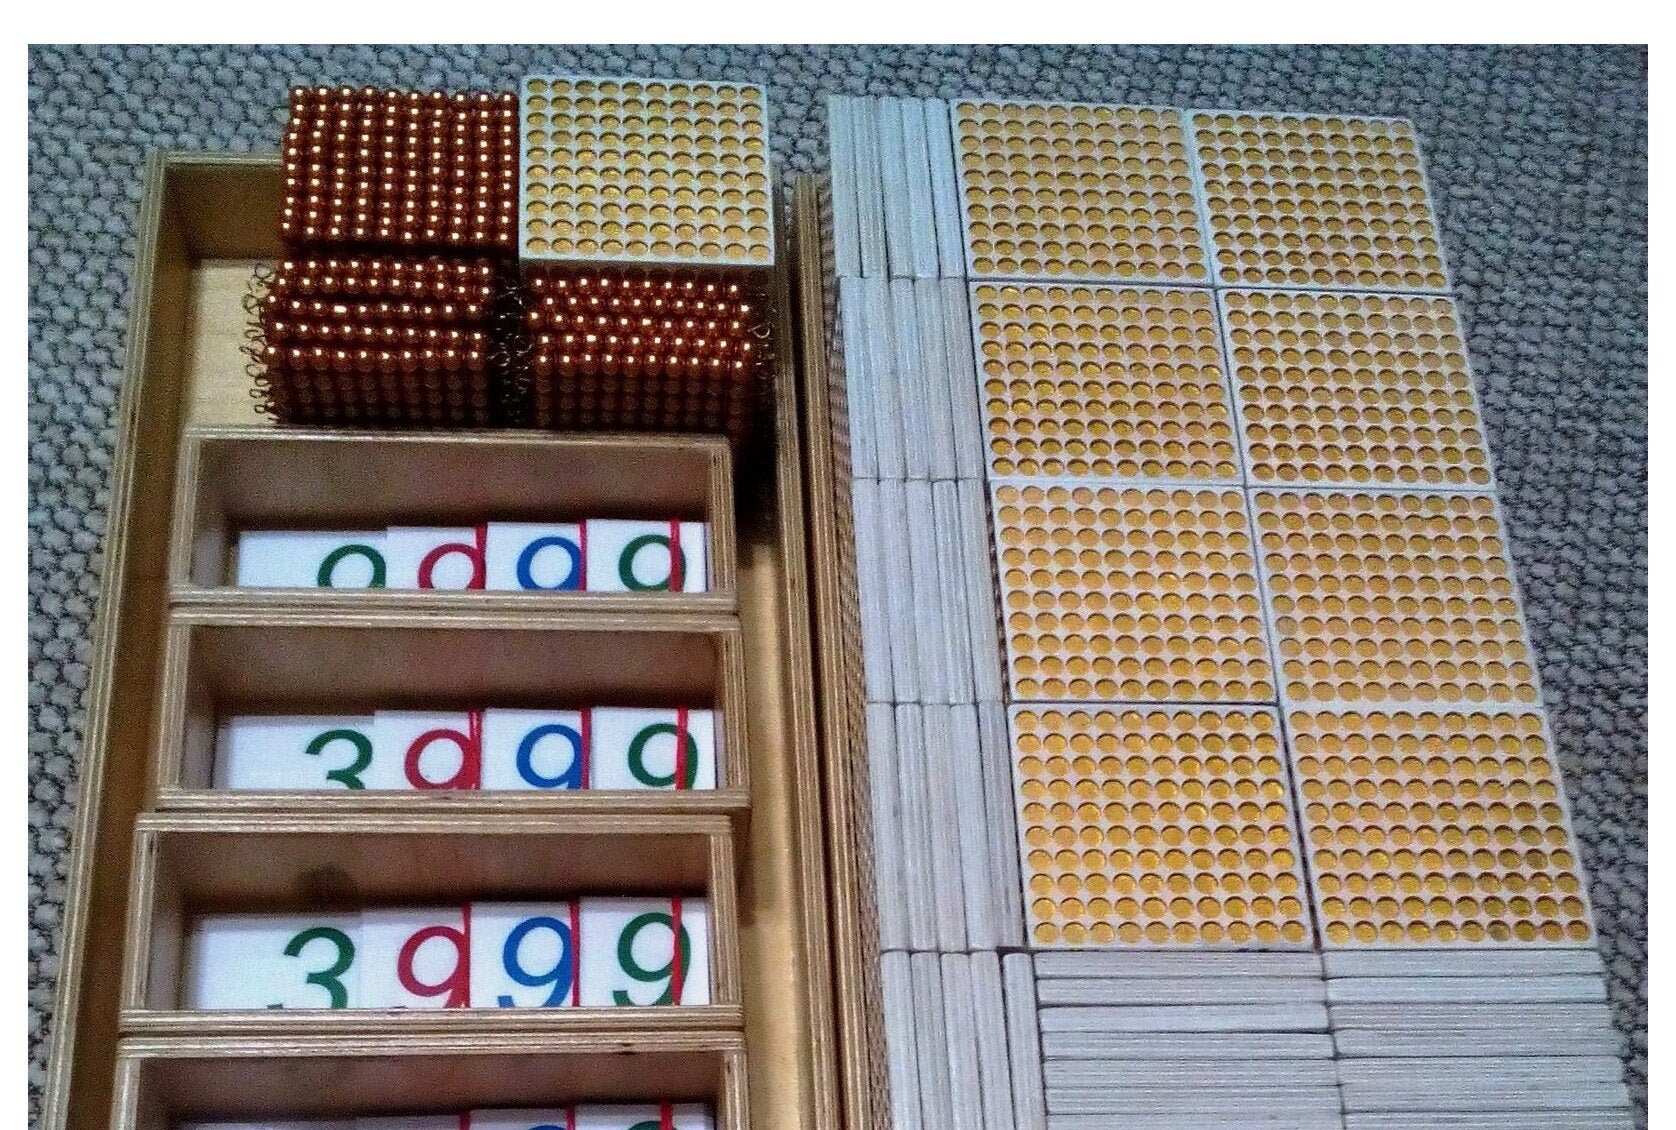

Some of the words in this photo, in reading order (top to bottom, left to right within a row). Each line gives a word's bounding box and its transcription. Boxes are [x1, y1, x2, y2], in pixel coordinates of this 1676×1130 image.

[267, 927, 356, 1009] 3
[497, 917, 575, 1008] 9
[613, 912, 692, 1006] 9
